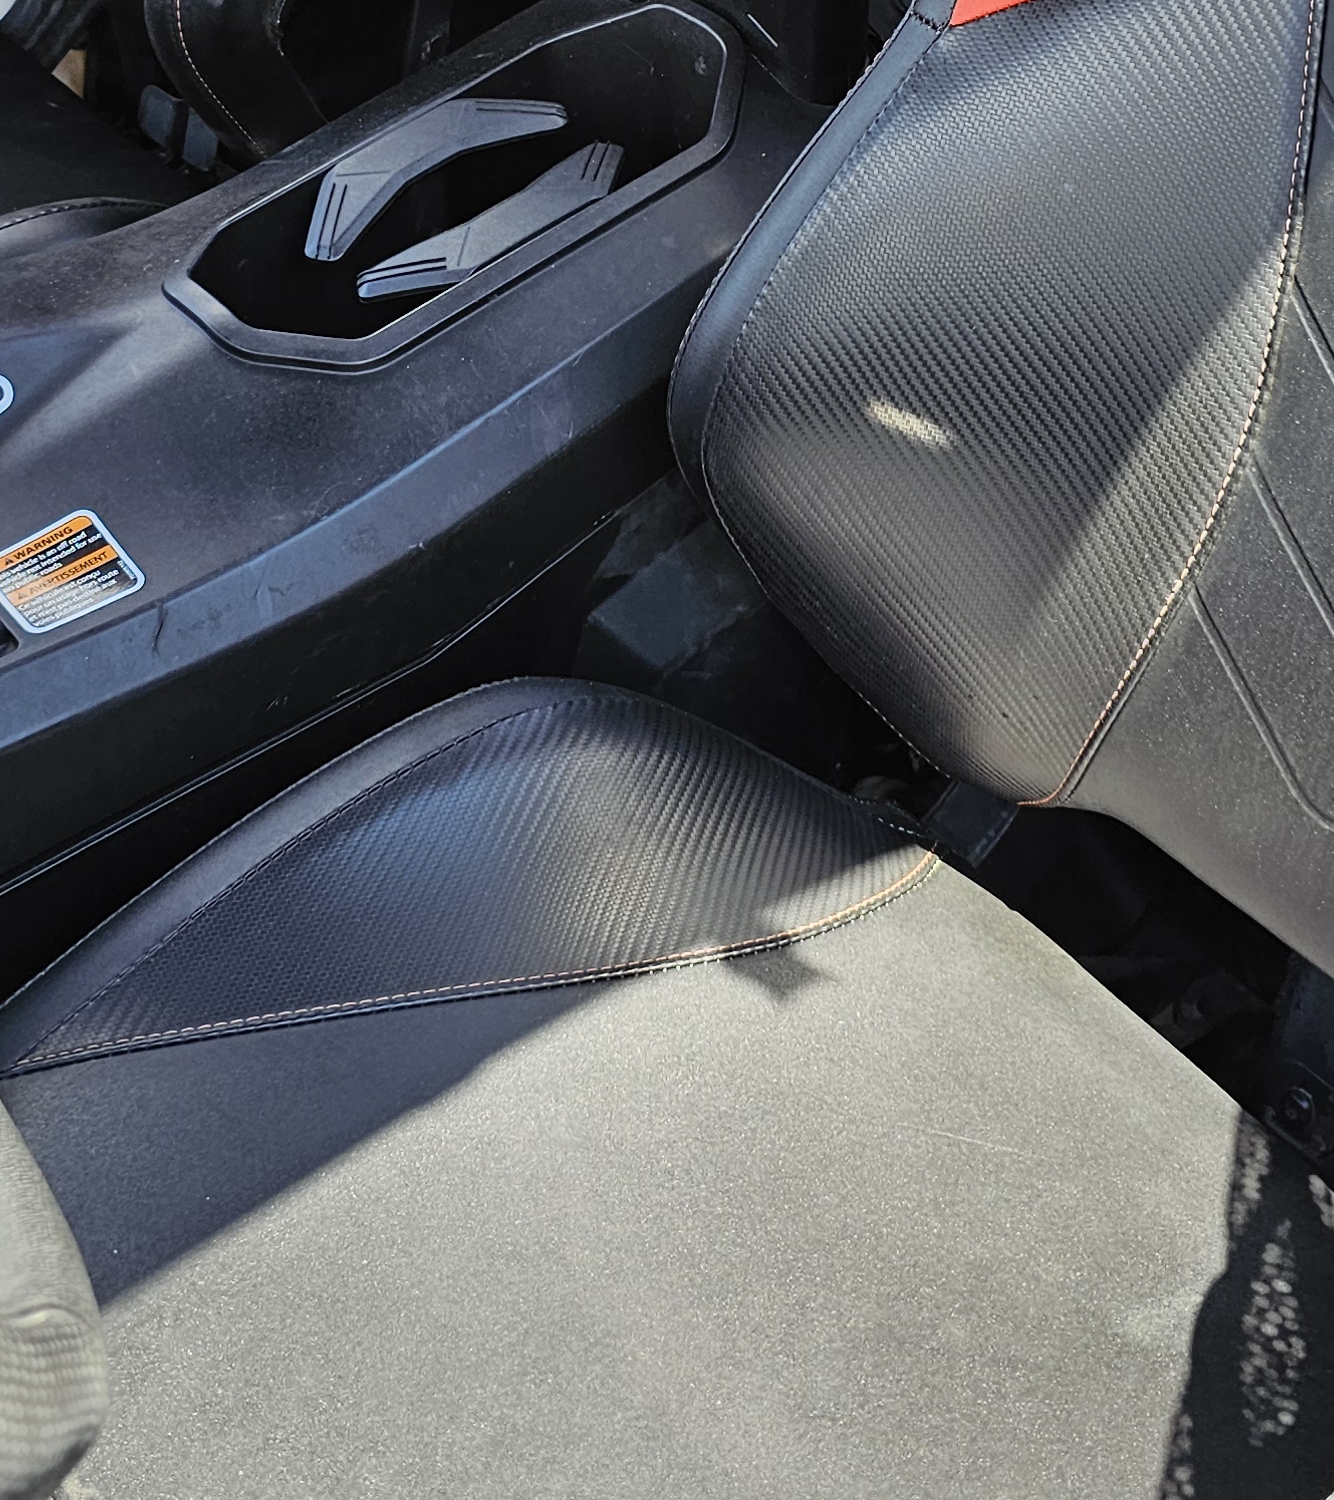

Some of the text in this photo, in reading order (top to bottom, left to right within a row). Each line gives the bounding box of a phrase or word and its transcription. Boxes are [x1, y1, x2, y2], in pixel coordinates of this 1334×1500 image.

[8, 555, 39, 574] vehicle
[37, 552, 46, 560] is
[44, 547, 57, 557] an
[54, 539, 69, 551] off
[66, 530, 87, 545] road
[11, 525, 74, 561] WARNING
[25, 562, 42, 574] not
[39, 544, 77, 567] intended
[74, 539, 88, 549] for
[86, 532, 102, 543] use
[14, 571, 42, 590] public
[38, 560, 63, 576] roads
[27, 550, 110, 595] AVERTISSEMENT
[95, 567, 119, 583] route
